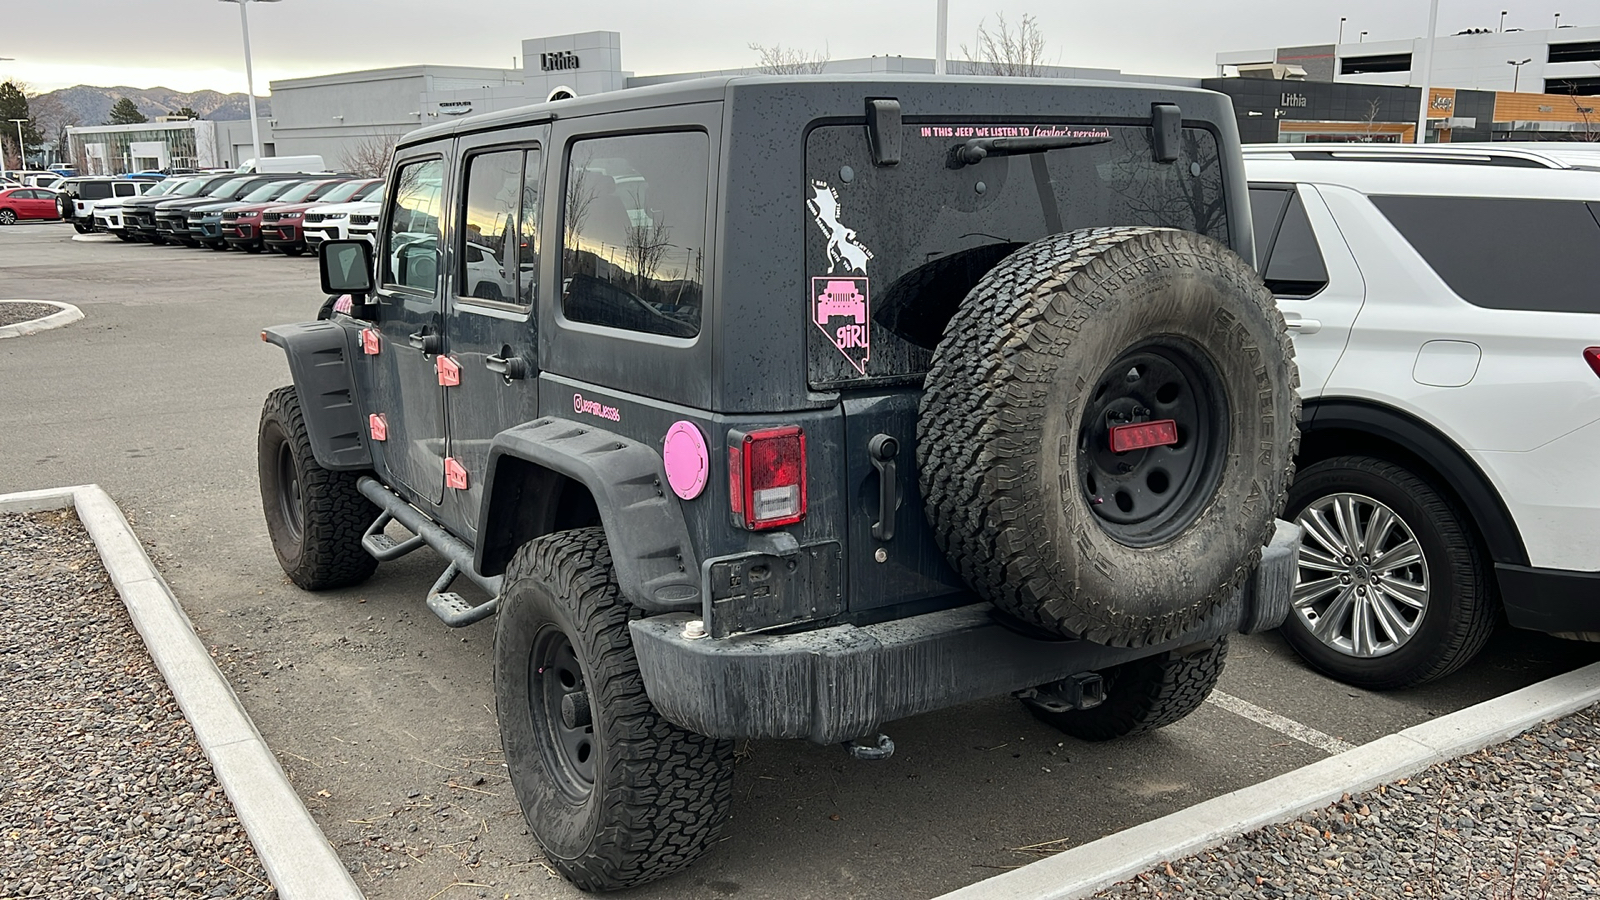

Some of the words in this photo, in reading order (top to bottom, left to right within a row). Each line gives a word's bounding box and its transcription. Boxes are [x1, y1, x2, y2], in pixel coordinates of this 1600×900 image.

[540, 51, 580, 71] Lithia
[1281, 92, 1307, 107] Lithia
[1431, 93, 1453, 112] Jeep
[921, 127, 932, 137] IN
[933, 127, 953, 137] THIS
[955, 127, 974, 137] JEEP
[975, 127, 990, 137] WE
[991, 127, 1018, 138] LISTEN
[1019, 127, 1030, 137] TO
[1058, 366, 1118, 581] GENERAL
